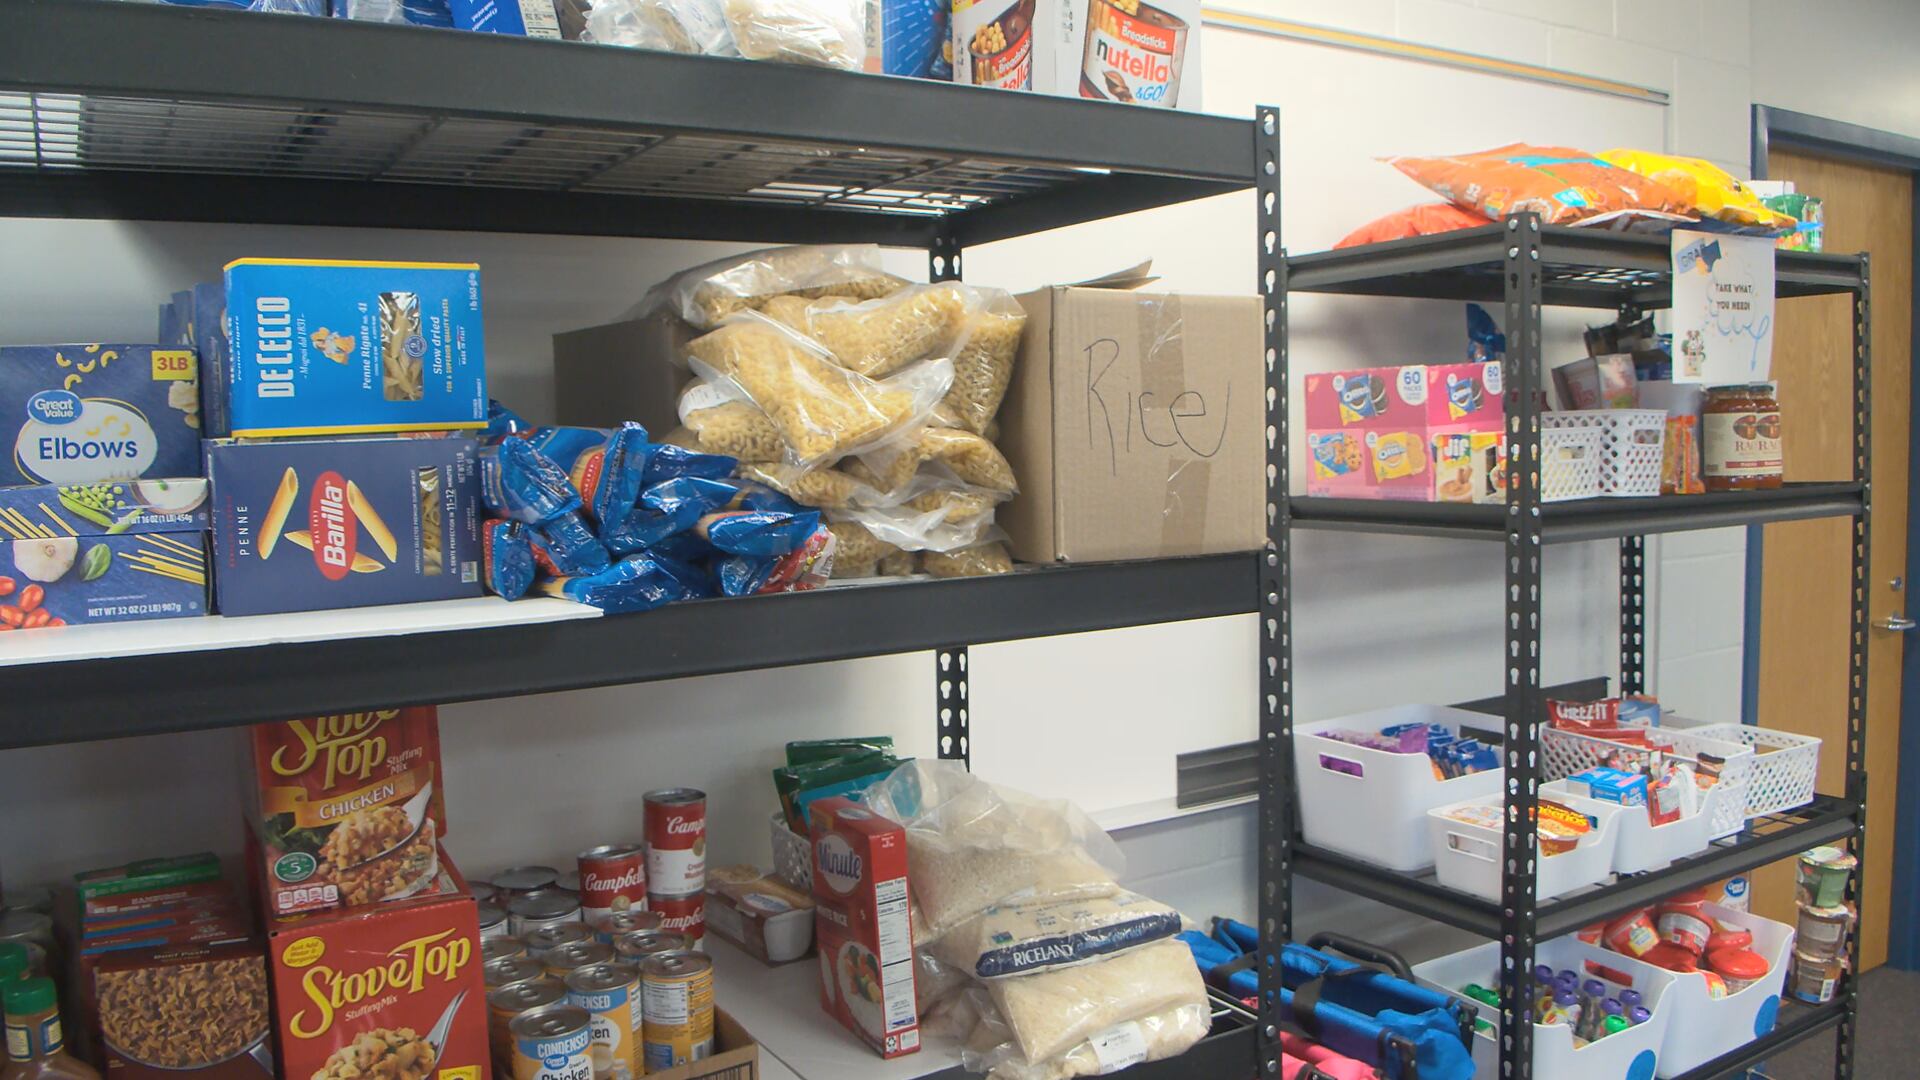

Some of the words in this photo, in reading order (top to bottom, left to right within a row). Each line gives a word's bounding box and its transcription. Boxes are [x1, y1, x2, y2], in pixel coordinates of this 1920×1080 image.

[1121, 25, 1167, 49] Breadsticks
[1096, 38, 1168, 83] nutella
[1716, 283, 1731, 293] TAKE
[1716, 301, 1729, 310] YOU
[256, 297, 293, 364] CECCO
[360, 325, 370, 358] Rigate
[430, 316, 440, 346] dried
[157, 357, 188, 371] 3LB
[432, 349, 442, 374] Slow
[1487, 366, 1499, 378] 60
[361, 360, 371, 389] Penne
[1404, 371, 1420, 384] 60
[34, 398, 74, 411] Great
[44, 408, 74, 418] Value
[1083, 338, 1231, 476] Rice
[39, 437, 138, 460] Elbows
[446, 489, 456, 511] 11-12
[236, 506, 250, 556] PENNE
[320, 486, 346, 566] Barilla
[88, 608, 103, 617] NET
[104, 607, 117, 616] WT
[118, 606, 128, 615] 32
[128, 606, 139, 614] OZ
[308, 730, 387, 790] Top
[386, 746, 423, 768] Stuffing
[390, 762, 408, 775] Mix
[319, 783, 395, 820] CHICKEN
[290, 862, 301, 874] 5
[819, 842, 860, 879] Minute
[1013, 943, 1074, 967] RICELAND
[345, 1001, 380, 1022] Stuffing
[380, 995, 398, 1010] Mix
[537, 1030, 589, 1058] CONDENSED
